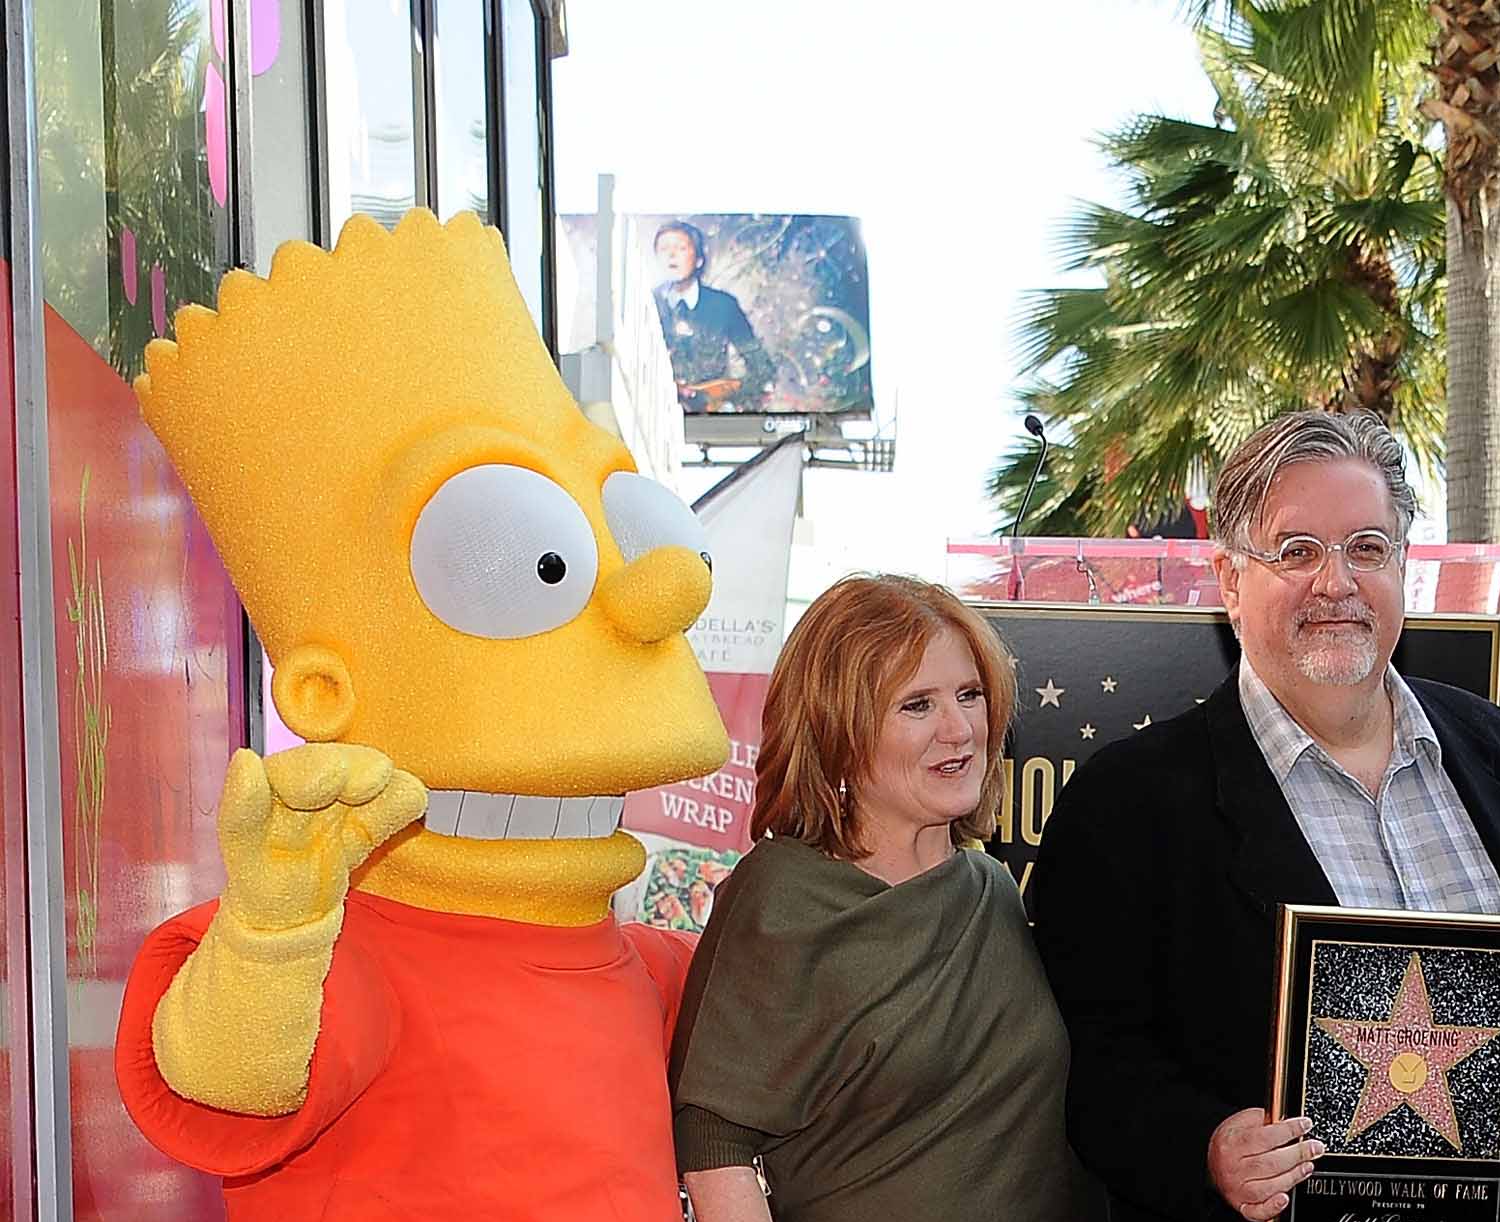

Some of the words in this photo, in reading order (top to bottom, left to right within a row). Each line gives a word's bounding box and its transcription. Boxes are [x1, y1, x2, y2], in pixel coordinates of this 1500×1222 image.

[696, 616, 776, 634] DELLA'S
[661, 791, 733, 833] WRAP
[1357, 1027, 1391, 1043] MATT
[1397, 1028, 1458, 1048] GROENING
[1306, 1178, 1383, 1196] HOLLYWOOD
[1390, 1181, 1426, 1198] WALK
[1433, 1183, 1449, 1199] OF
[1455, 1184, 1489, 1200] FAME
